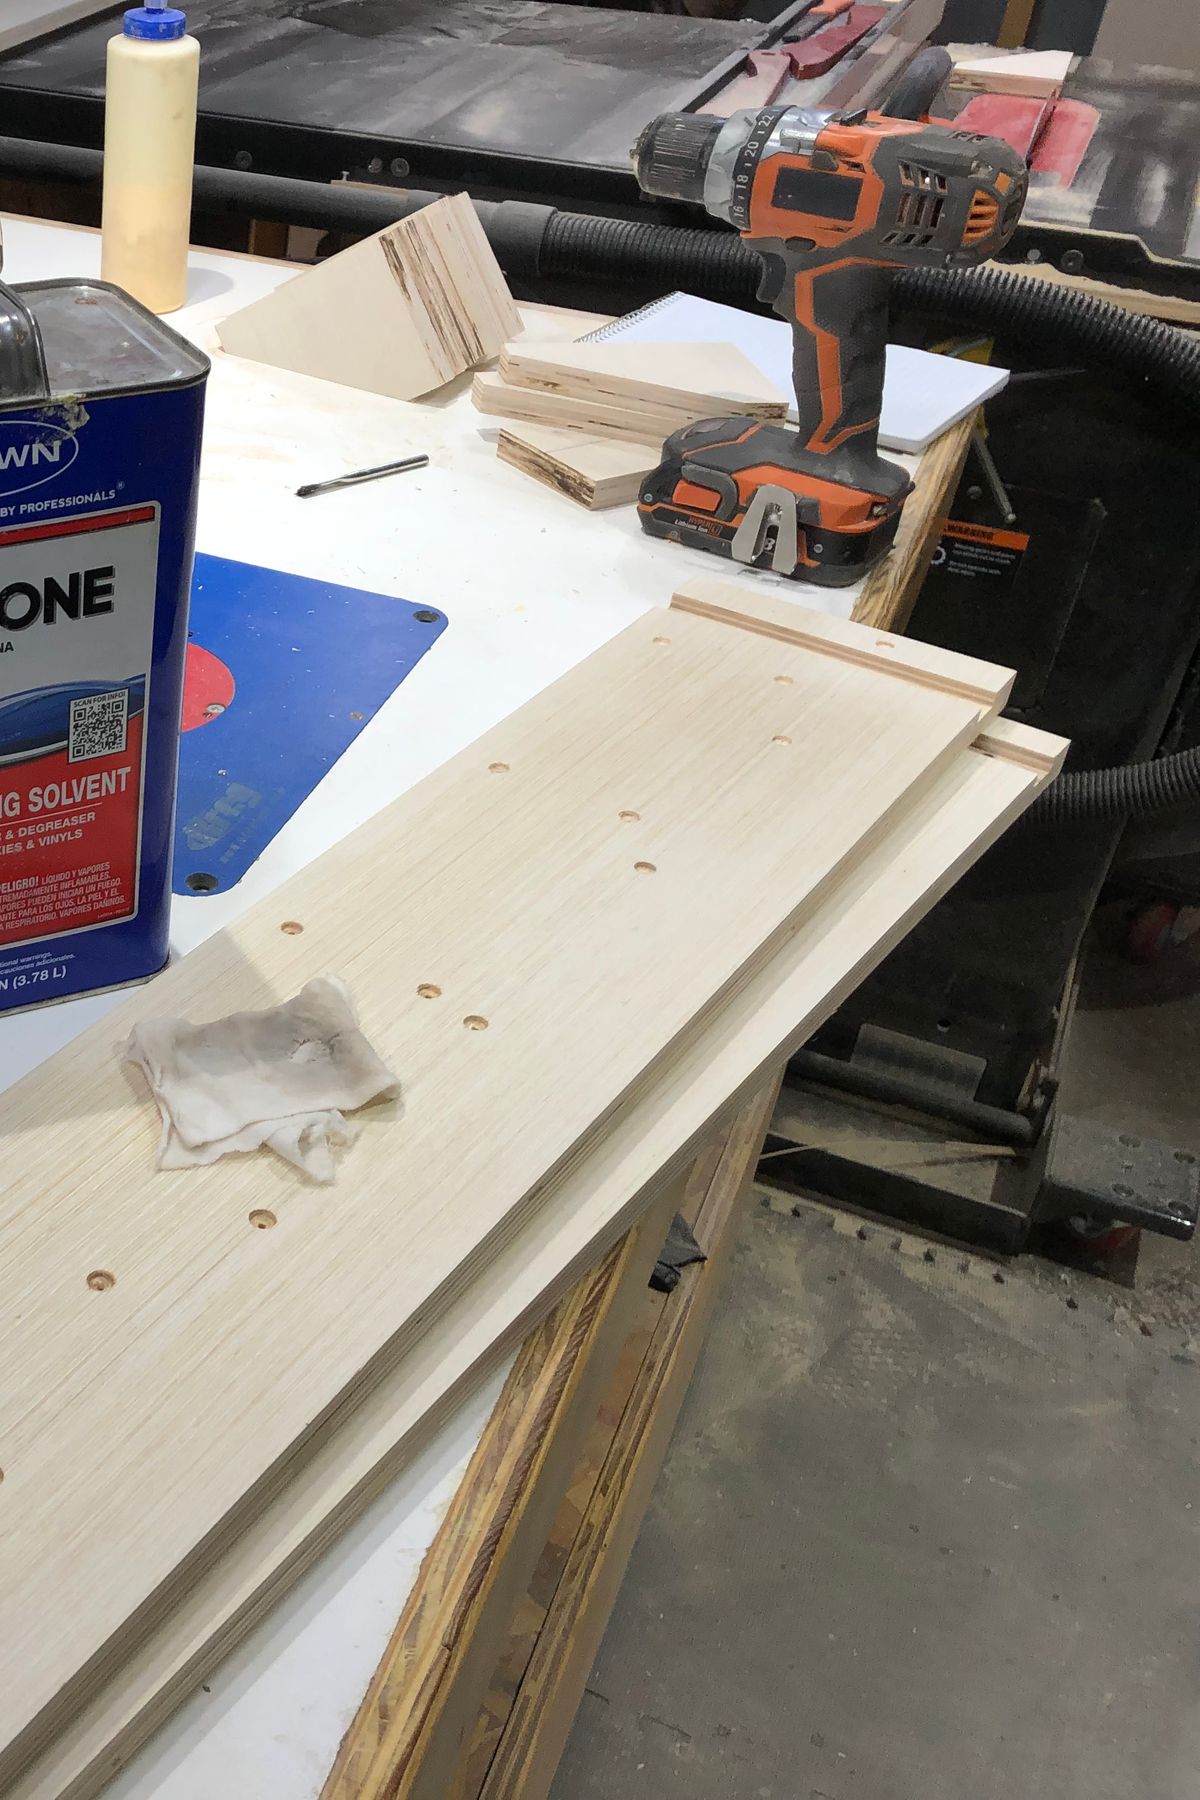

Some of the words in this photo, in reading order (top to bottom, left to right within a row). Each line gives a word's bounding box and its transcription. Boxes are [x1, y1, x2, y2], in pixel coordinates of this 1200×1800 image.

[758, 114, 775, 127] 22
[745, 141, 759, 158] 20
[736, 174, 749, 189] 18
[733, 205, 745, 218] 16
[0, 506, 16, 518] BY
[19, 490, 116, 515] PROFESSIONALS
[73, 699, 92, 708] SCAN
[93, 695, 107, 704] FOR
[28, 767, 131, 813] SOLVENT
[6, 829, 15, 840] &
[18, 811, 96, 838] DEGREASER
[26, 839, 35, 850] &
[38, 829, 83, 847] VINYLS
[77, 862, 111, 877] VAPORES
[18, 907, 38, 918] PARA
[39, 903, 54, 913] LOS
[77, 895, 87, 905] LA
[88, 892, 102, 903] PIEL
[27, 893, 57, 907] PUEDEN
[58, 887, 84, 900] INICIAR
[85, 884, 96, 893] UN
[59, 904, 92, 918] VAPORES
[12, 969, 49, 990] (3.78
[52, 964, 67, 979] L)
